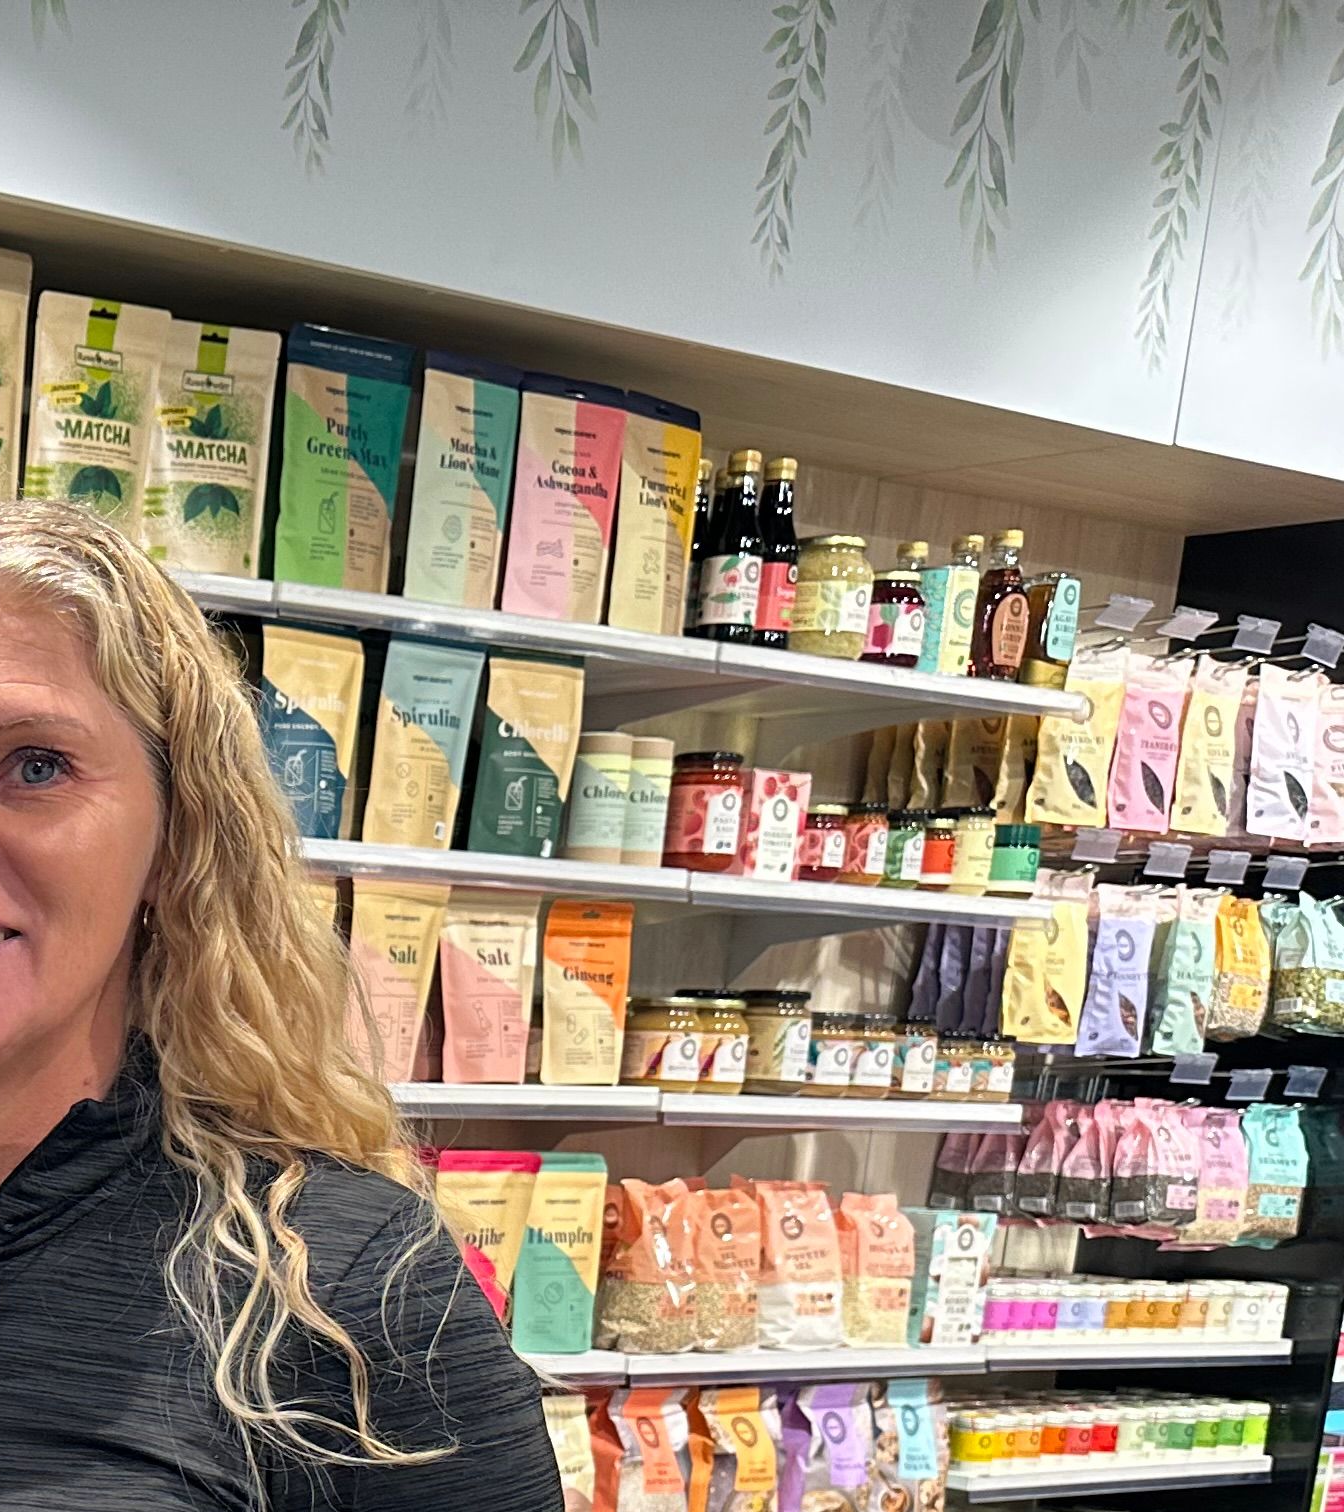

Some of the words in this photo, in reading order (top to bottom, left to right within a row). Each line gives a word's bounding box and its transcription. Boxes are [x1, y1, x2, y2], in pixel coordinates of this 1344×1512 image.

[64, 418, 131, 447] MATCHA
[174, 439, 248, 466] MATCHA
[388, 944, 418, 966] Salt
[477, 947, 512, 967] Salt
[562, 965, 616, 987] Ginseng
